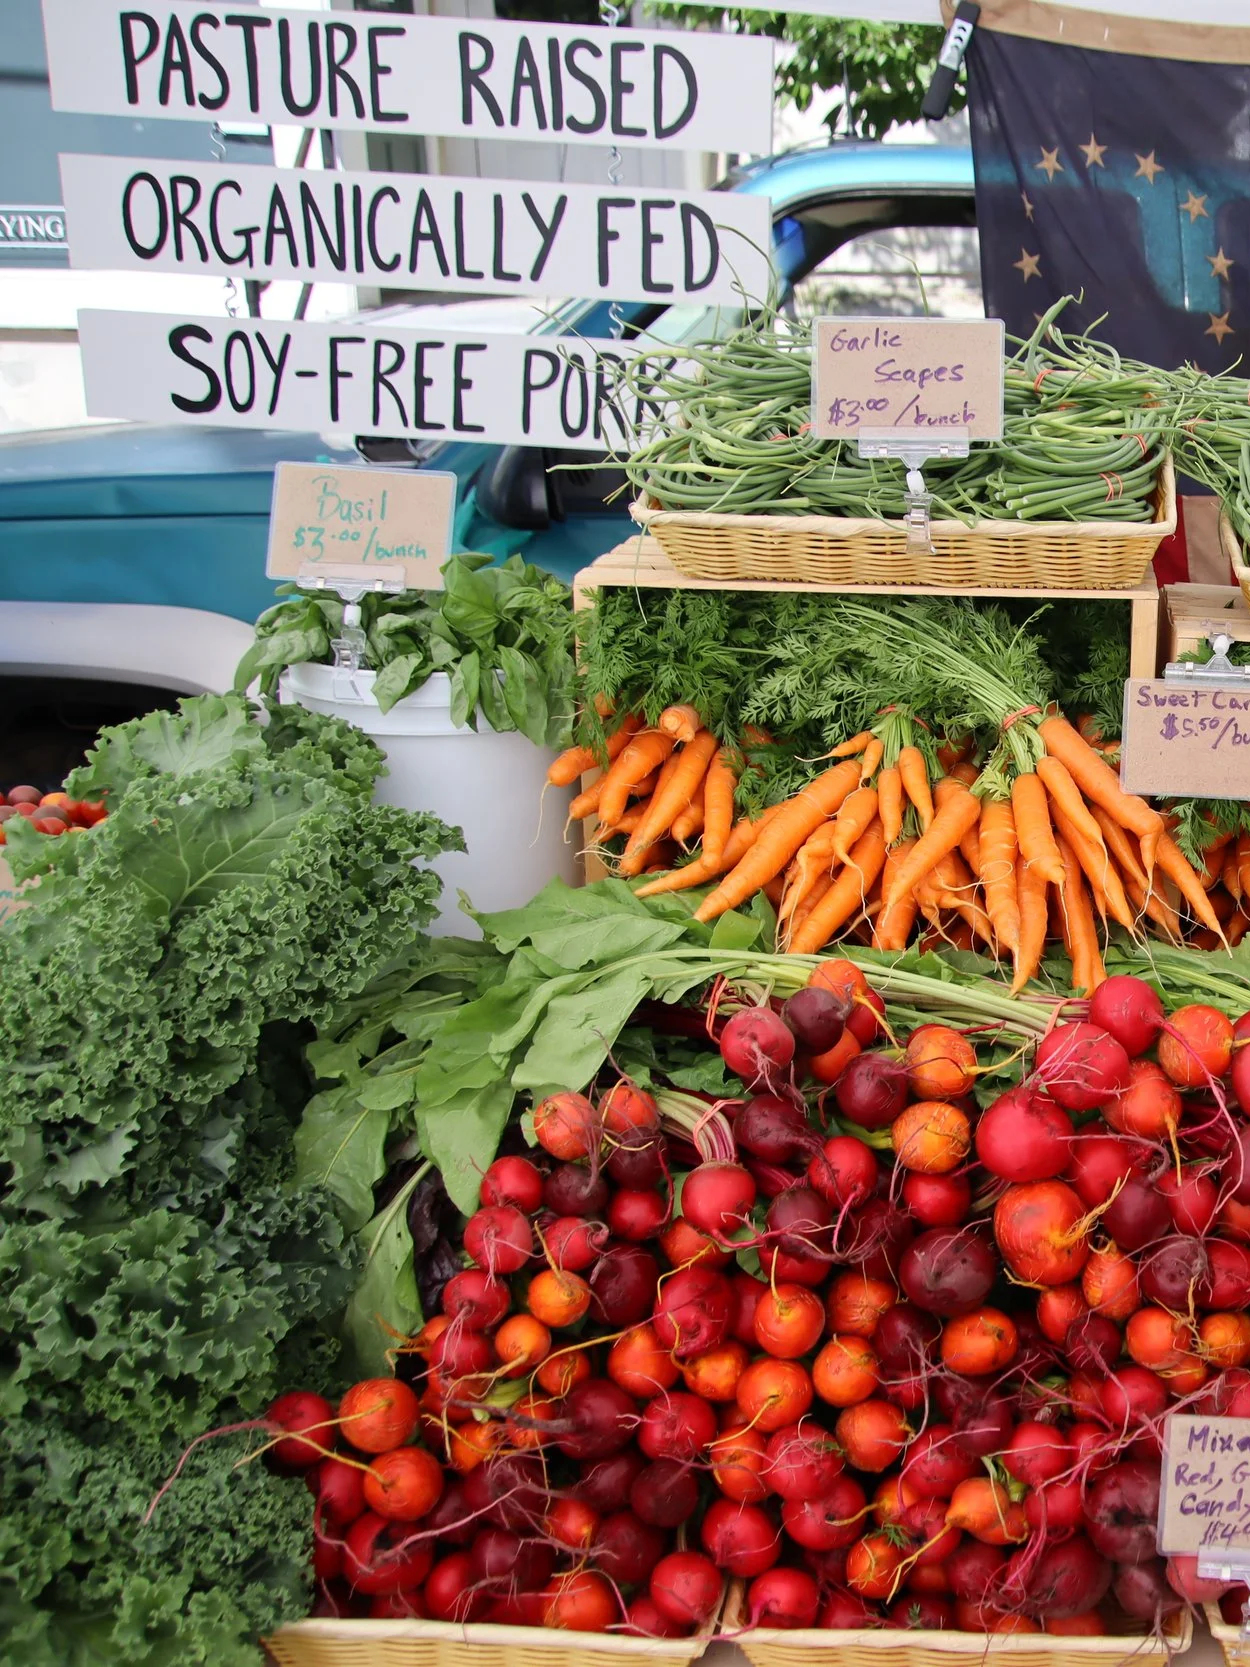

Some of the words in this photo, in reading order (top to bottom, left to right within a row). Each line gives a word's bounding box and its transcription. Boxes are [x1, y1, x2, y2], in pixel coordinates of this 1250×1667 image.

[120, 11, 410, 123] PASTURE
[459, 31, 699, 140] RAISED
[0, 214, 65, 239] YING
[122, 171, 568, 283] ORGANICALLY
[598, 197, 721, 293] FED
[830, 328, 903, 351] Garlic
[168, 323, 487, 433] SOY-FREE
[522, 349, 677, 440] PORK
[874, 359, 965, 389] Scapes
[312, 475, 388, 523] Basil
[1137, 686, 1207, 708] Sweet
[1175, 1462, 1224, 1495] Red,
